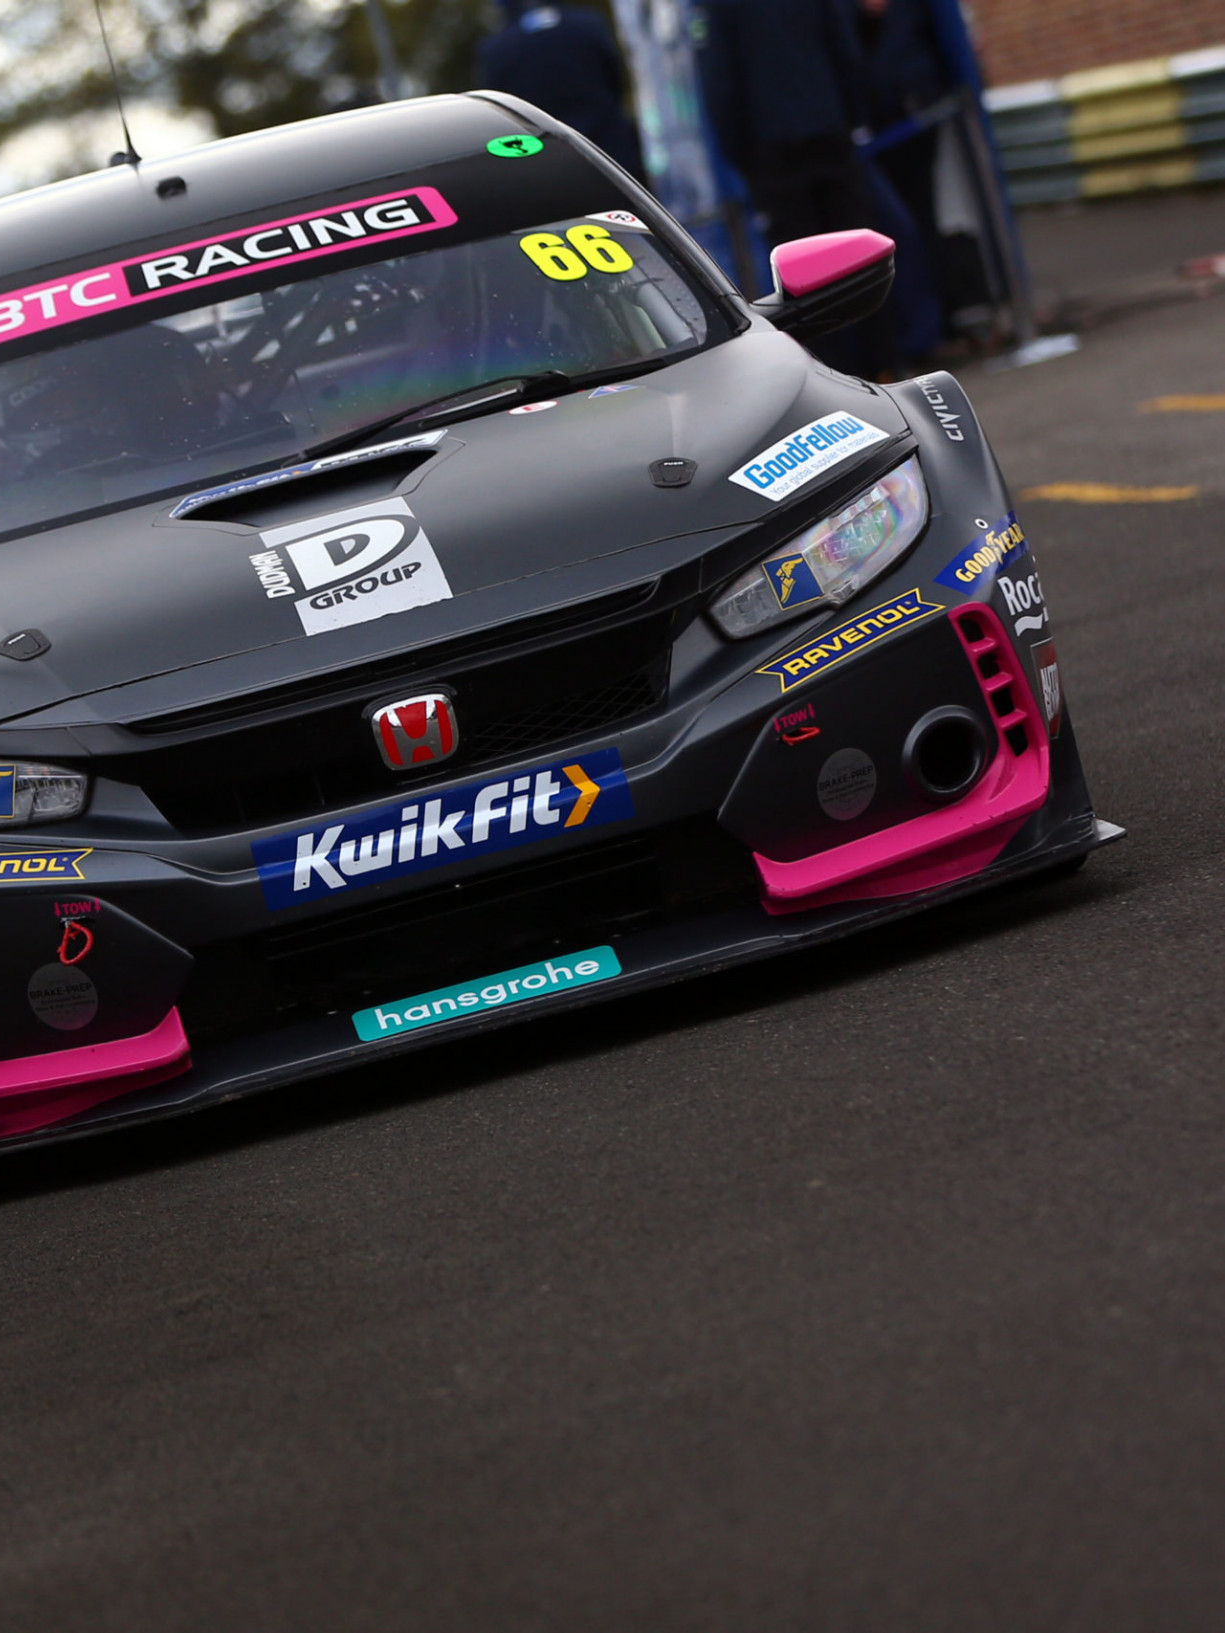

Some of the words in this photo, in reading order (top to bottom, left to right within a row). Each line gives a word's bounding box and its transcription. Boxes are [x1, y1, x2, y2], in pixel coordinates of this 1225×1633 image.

[140, 199, 421, 289] RACING
[519, 224, 634, 281] 66
[249, 550, 296, 599] DUDMAN
[309, 561, 422, 610] GROUP
[782, 601, 921, 677] RAVENOL
[780, 708, 808, 728] TOW
[61, 901, 92, 915] TOW
[374, 960, 600, 1030] hansgrohe
